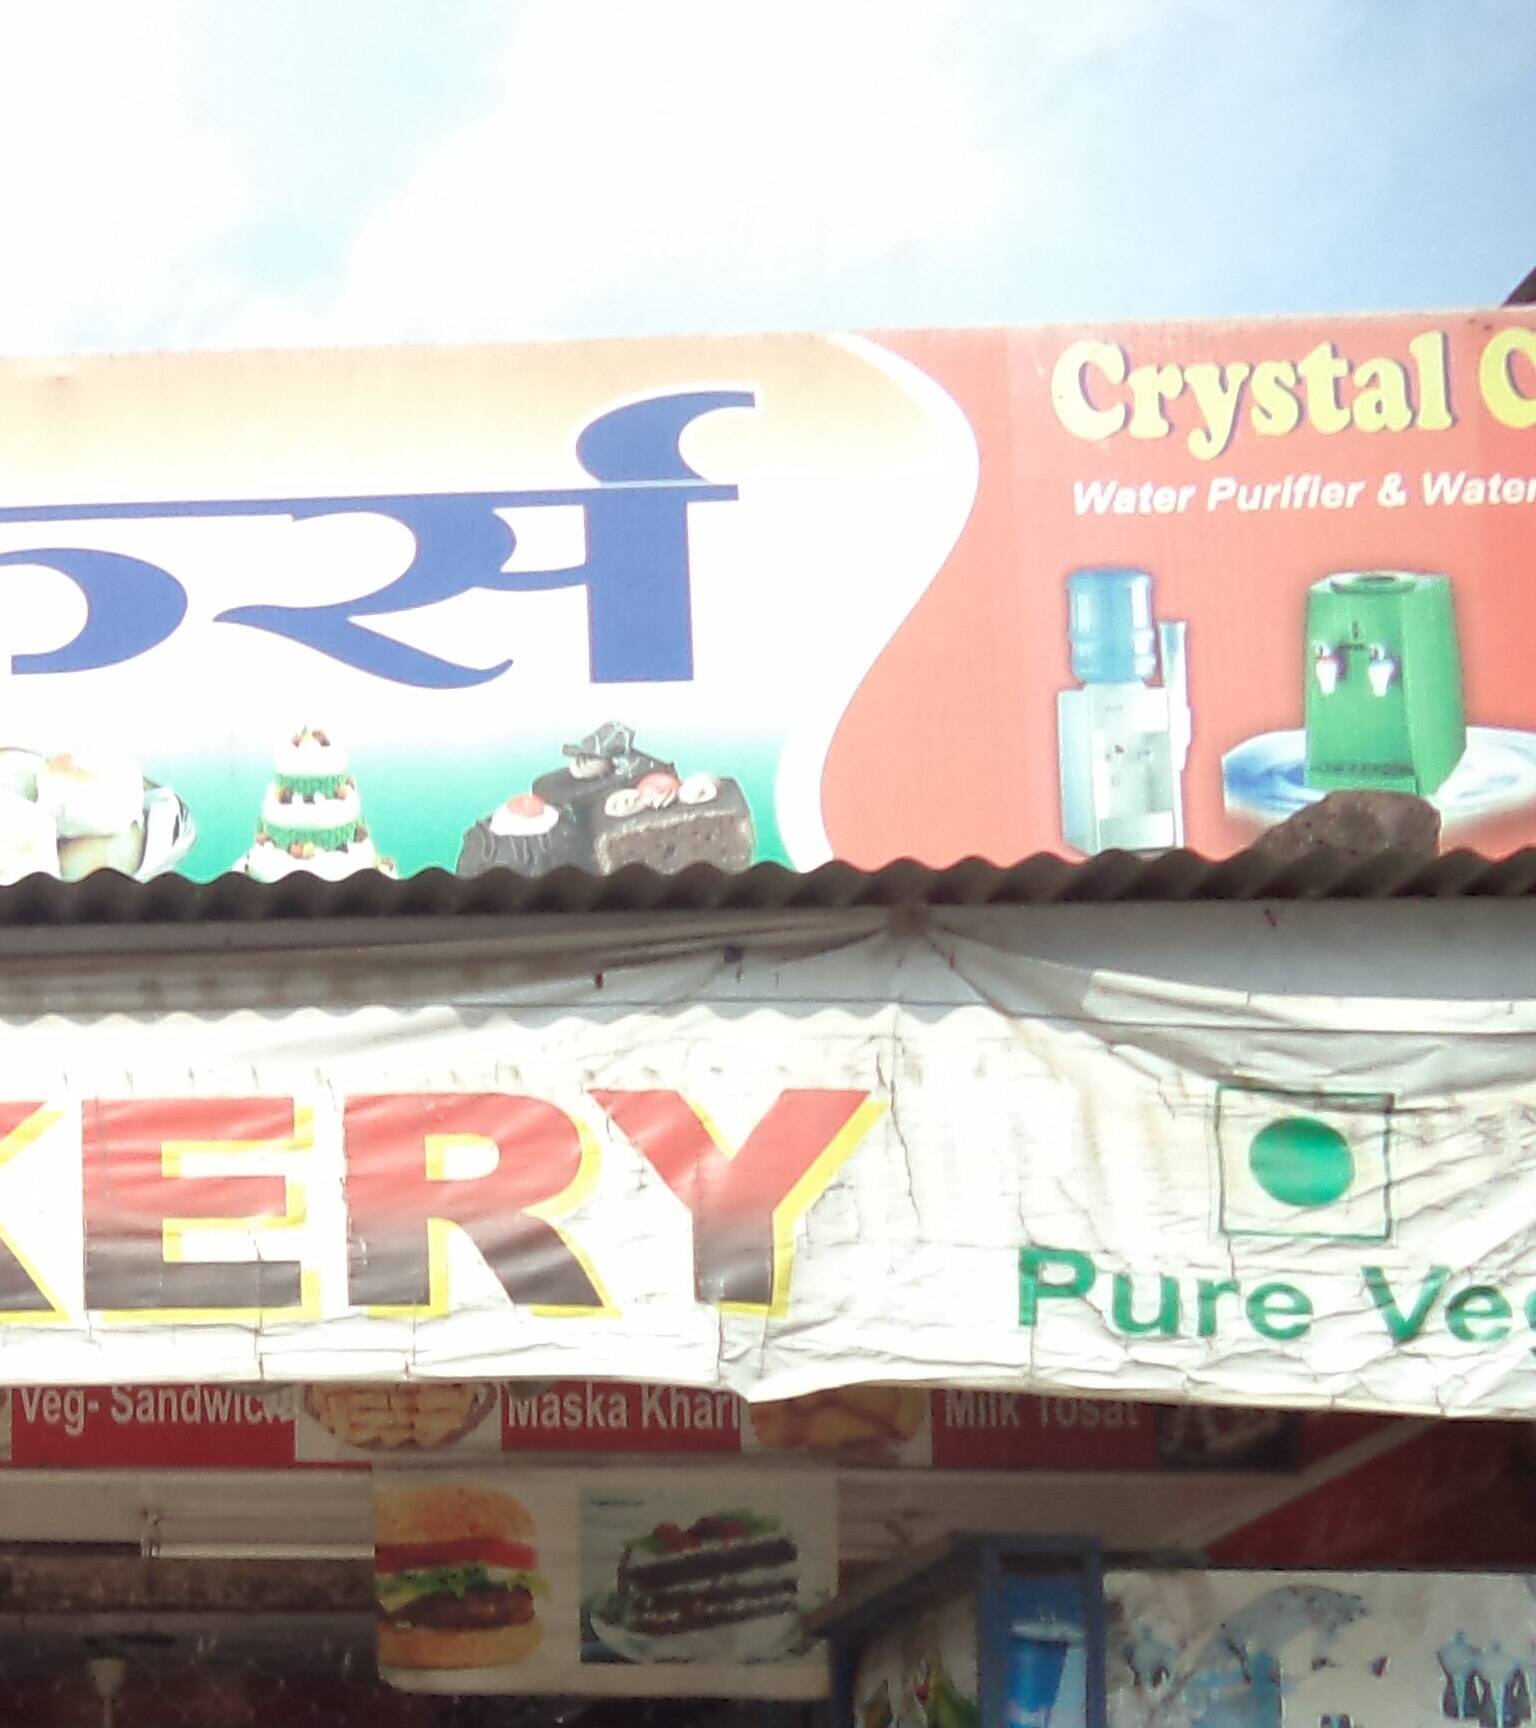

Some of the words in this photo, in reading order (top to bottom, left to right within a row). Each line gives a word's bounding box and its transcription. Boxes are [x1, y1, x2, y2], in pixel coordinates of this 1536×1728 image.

[1050, 330, 1458, 460] Crystal
[1071, 480, 1197, 516] Water
[1207, 472, 1367, 514] Purifier
[1375, 471, 1408, 508] &
[1017, 1246, 1313, 1341] Pure
[1360, 1264, 1536, 1359] Ve
[111, 1383, 295, 1425] Sandwic
